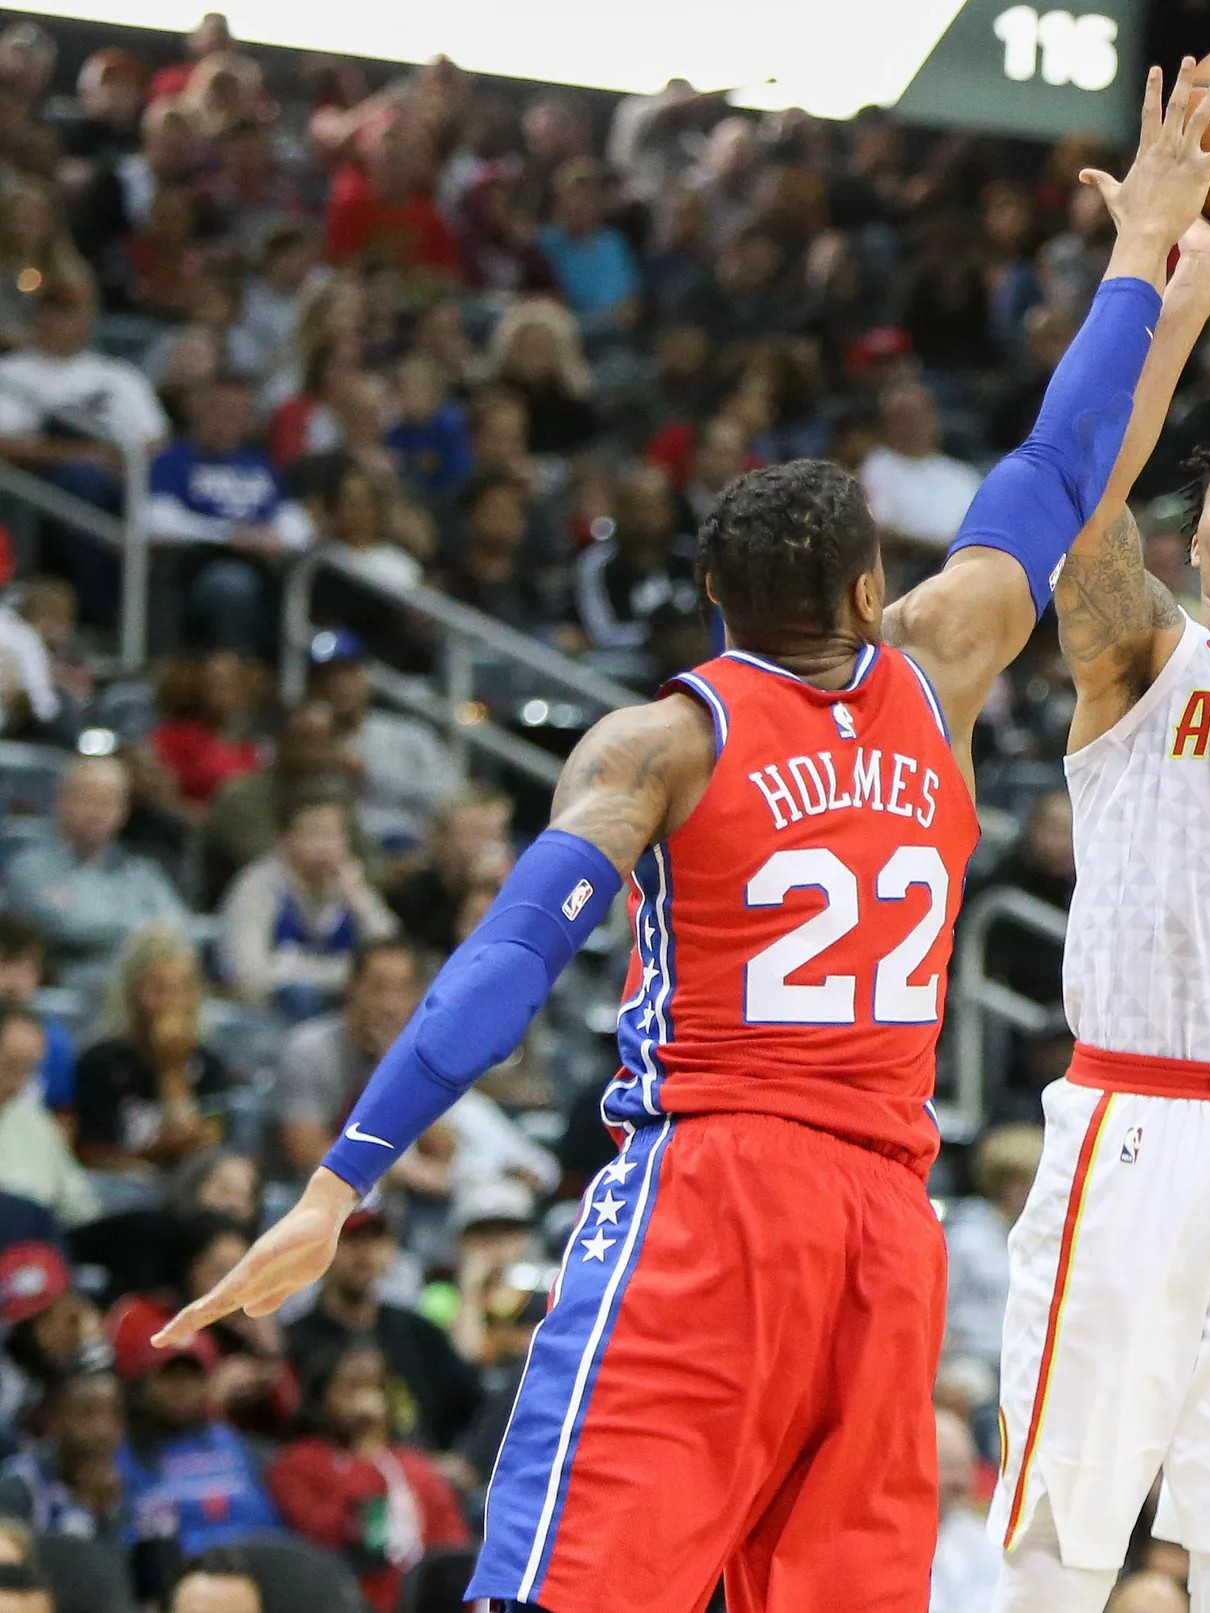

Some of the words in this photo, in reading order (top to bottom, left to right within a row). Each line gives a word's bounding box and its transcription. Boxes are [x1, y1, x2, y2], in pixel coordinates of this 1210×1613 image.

[993, 4, 1118, 91] 116
[748, 746, 941, 830] HOLMES
[743, 845, 950, 1025] 22
